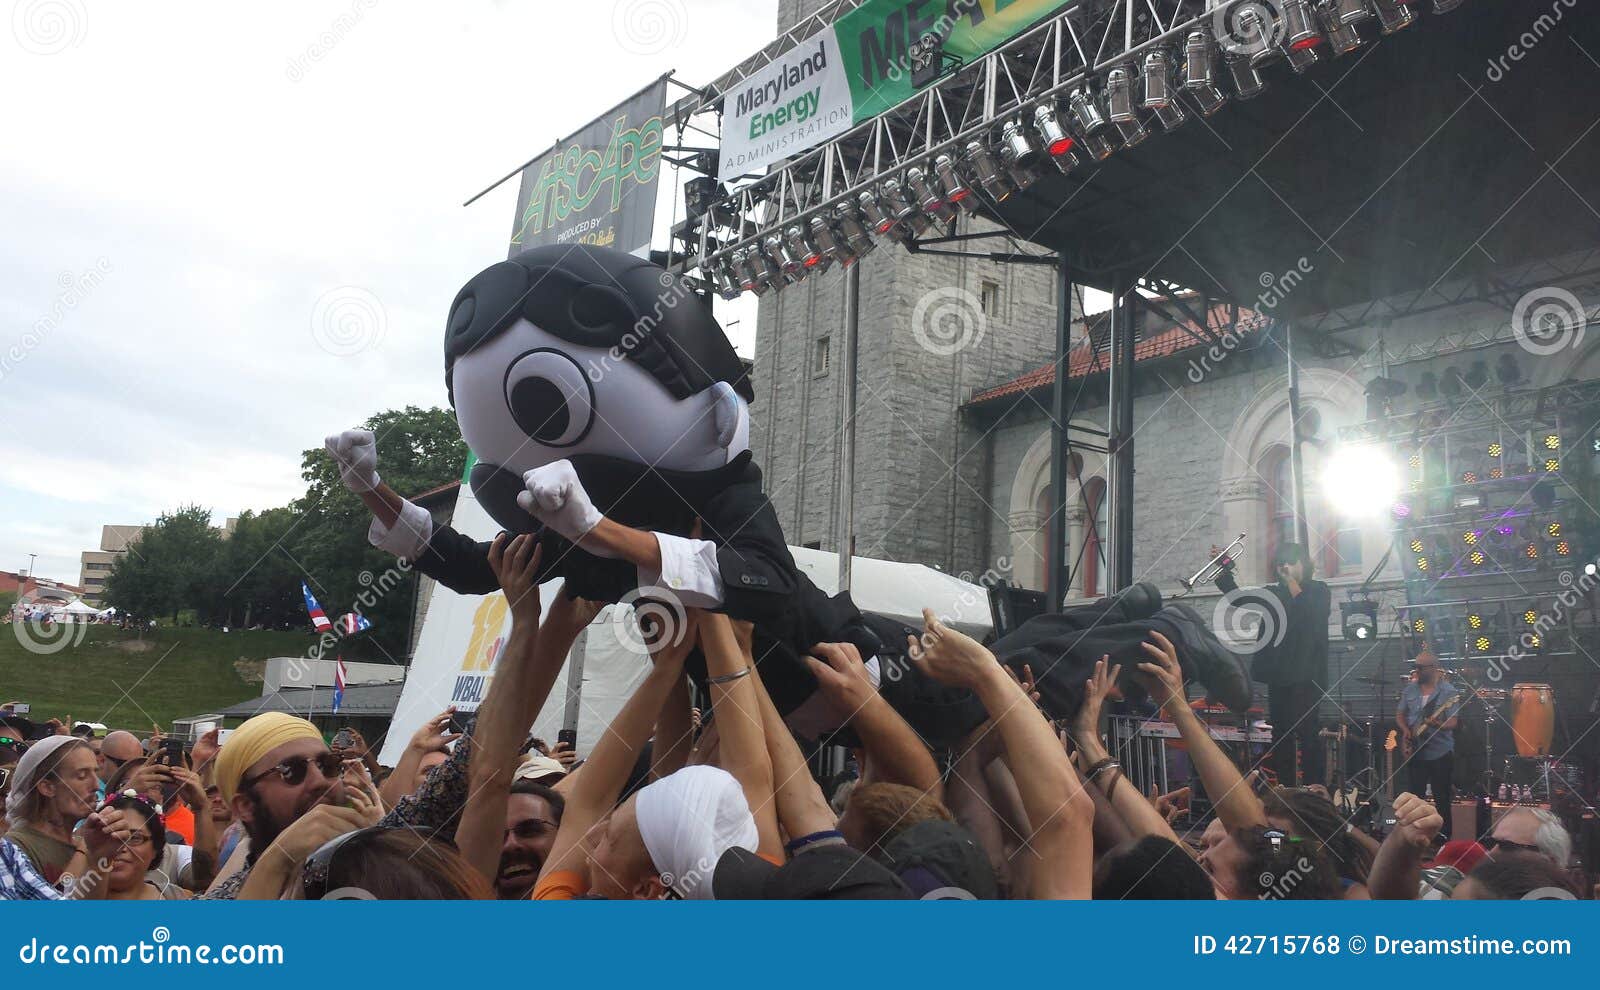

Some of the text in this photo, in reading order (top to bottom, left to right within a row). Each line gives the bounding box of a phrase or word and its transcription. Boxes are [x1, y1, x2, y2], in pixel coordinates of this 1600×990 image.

[735, 40, 827, 118] Maryland
[725, 104, 848, 170] ADMINISTRATION
[749, 86, 821, 140] Energy
[557, 220, 590, 244] PRODUCED
[590, 217, 602, 229] BY
[451, 675, 485, 703] WBAL
